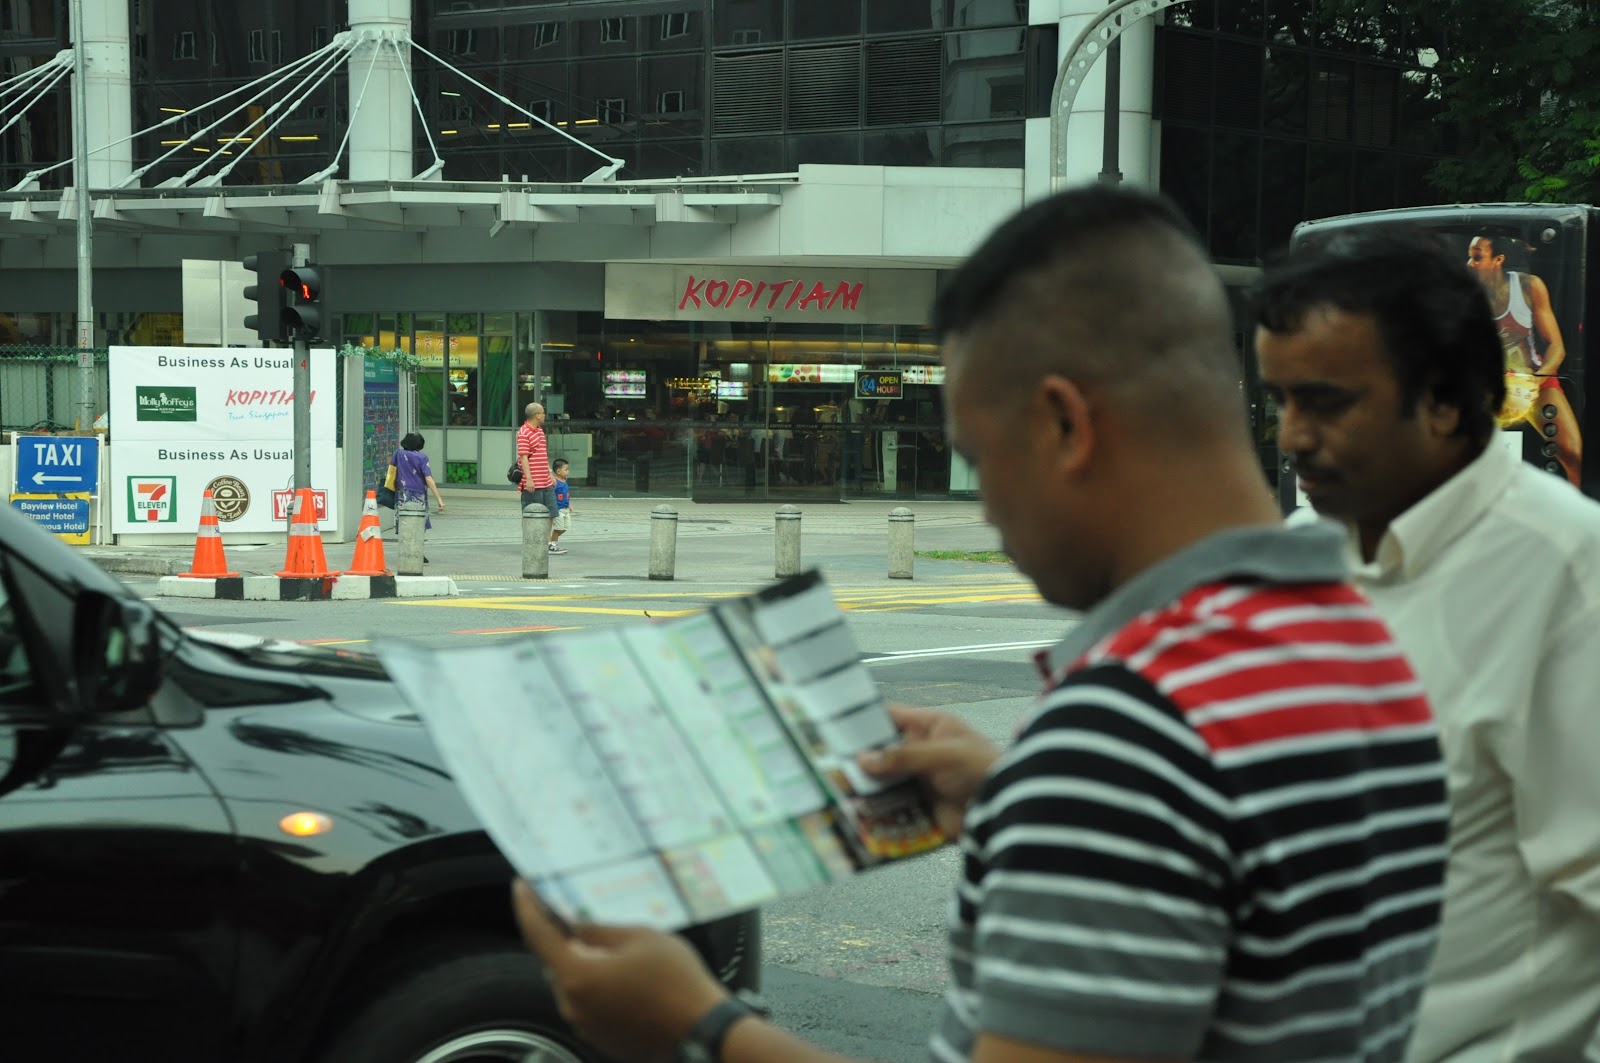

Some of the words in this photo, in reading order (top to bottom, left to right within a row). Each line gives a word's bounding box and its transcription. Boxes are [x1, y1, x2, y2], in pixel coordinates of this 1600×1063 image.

[678, 275, 864, 311] KOPITIAM
[158, 356, 225, 368] Business
[230, 357, 249, 368] As
[254, 357, 294, 369] Usual
[301, 359, 307, 369] 4
[861, 377, 876, 393] 24
[879, 376, 899, 384] OPEN
[248, 410, 290, 420] Singapore
[33, 443, 82, 467] TAXI
[158, 449, 225, 460] Business
[230, 449, 248, 460] As
[254, 449, 293, 460] Usual
[21, 502, 54, 511] Bayview
[56, 502, 78, 510] Hotel
[63, 523, 86, 531] Hotel
